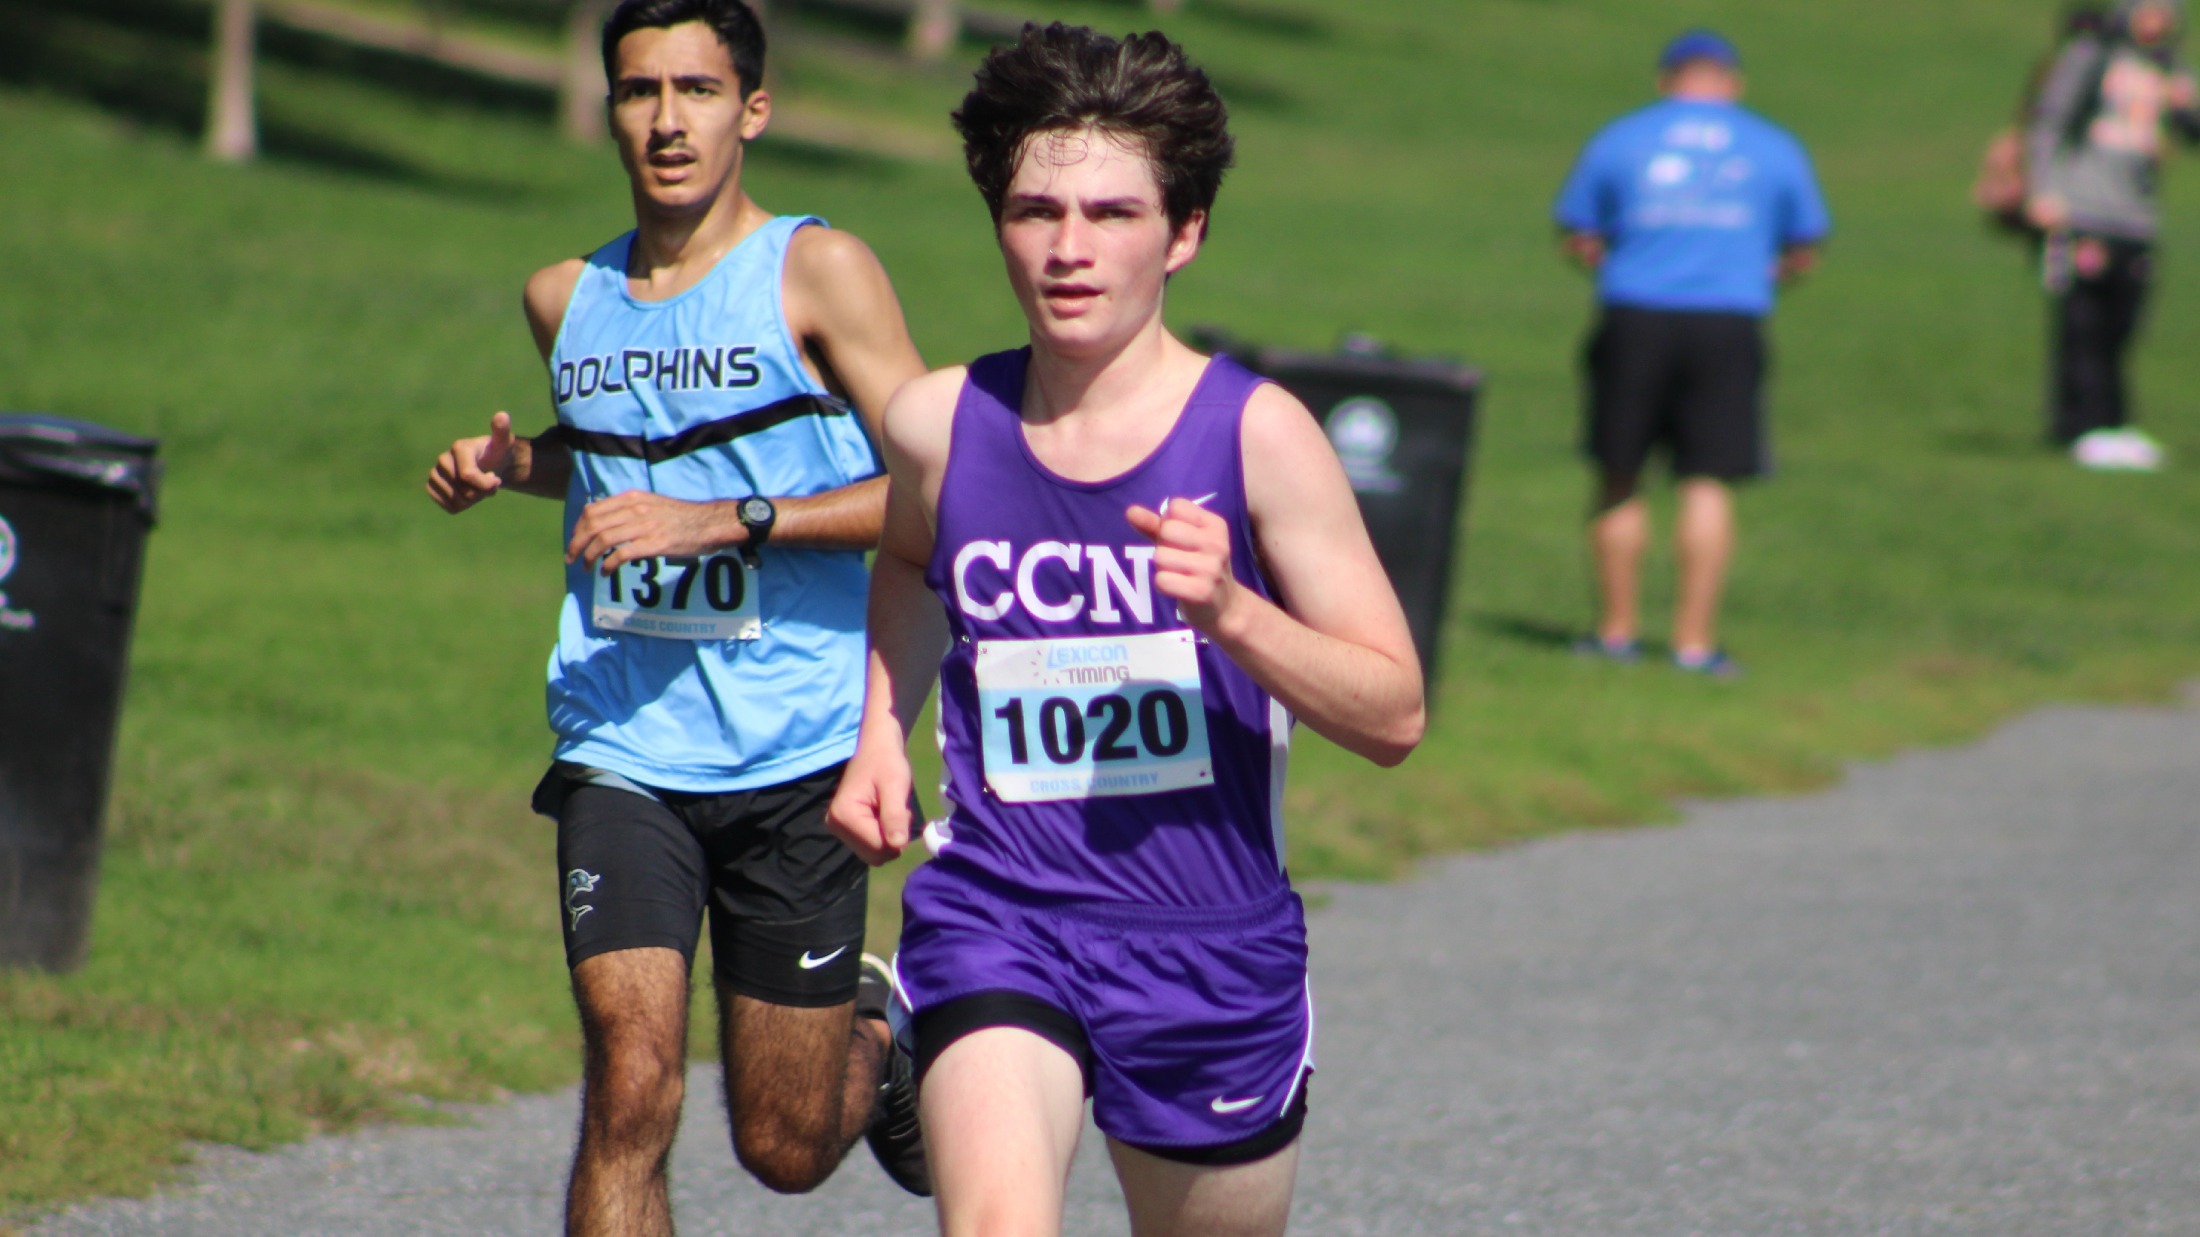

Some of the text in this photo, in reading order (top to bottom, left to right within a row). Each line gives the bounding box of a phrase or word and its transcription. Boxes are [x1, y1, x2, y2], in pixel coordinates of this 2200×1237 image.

[558, 347, 760, 404] DOLPHINS
[603, 549, 745, 612] 1370
[954, 540, 1183, 623] CCN
[659, 620, 717, 634] COUNTRY
[994, 690, 1188, 764] 1020
[1030, 779, 1080, 793] CROSS
